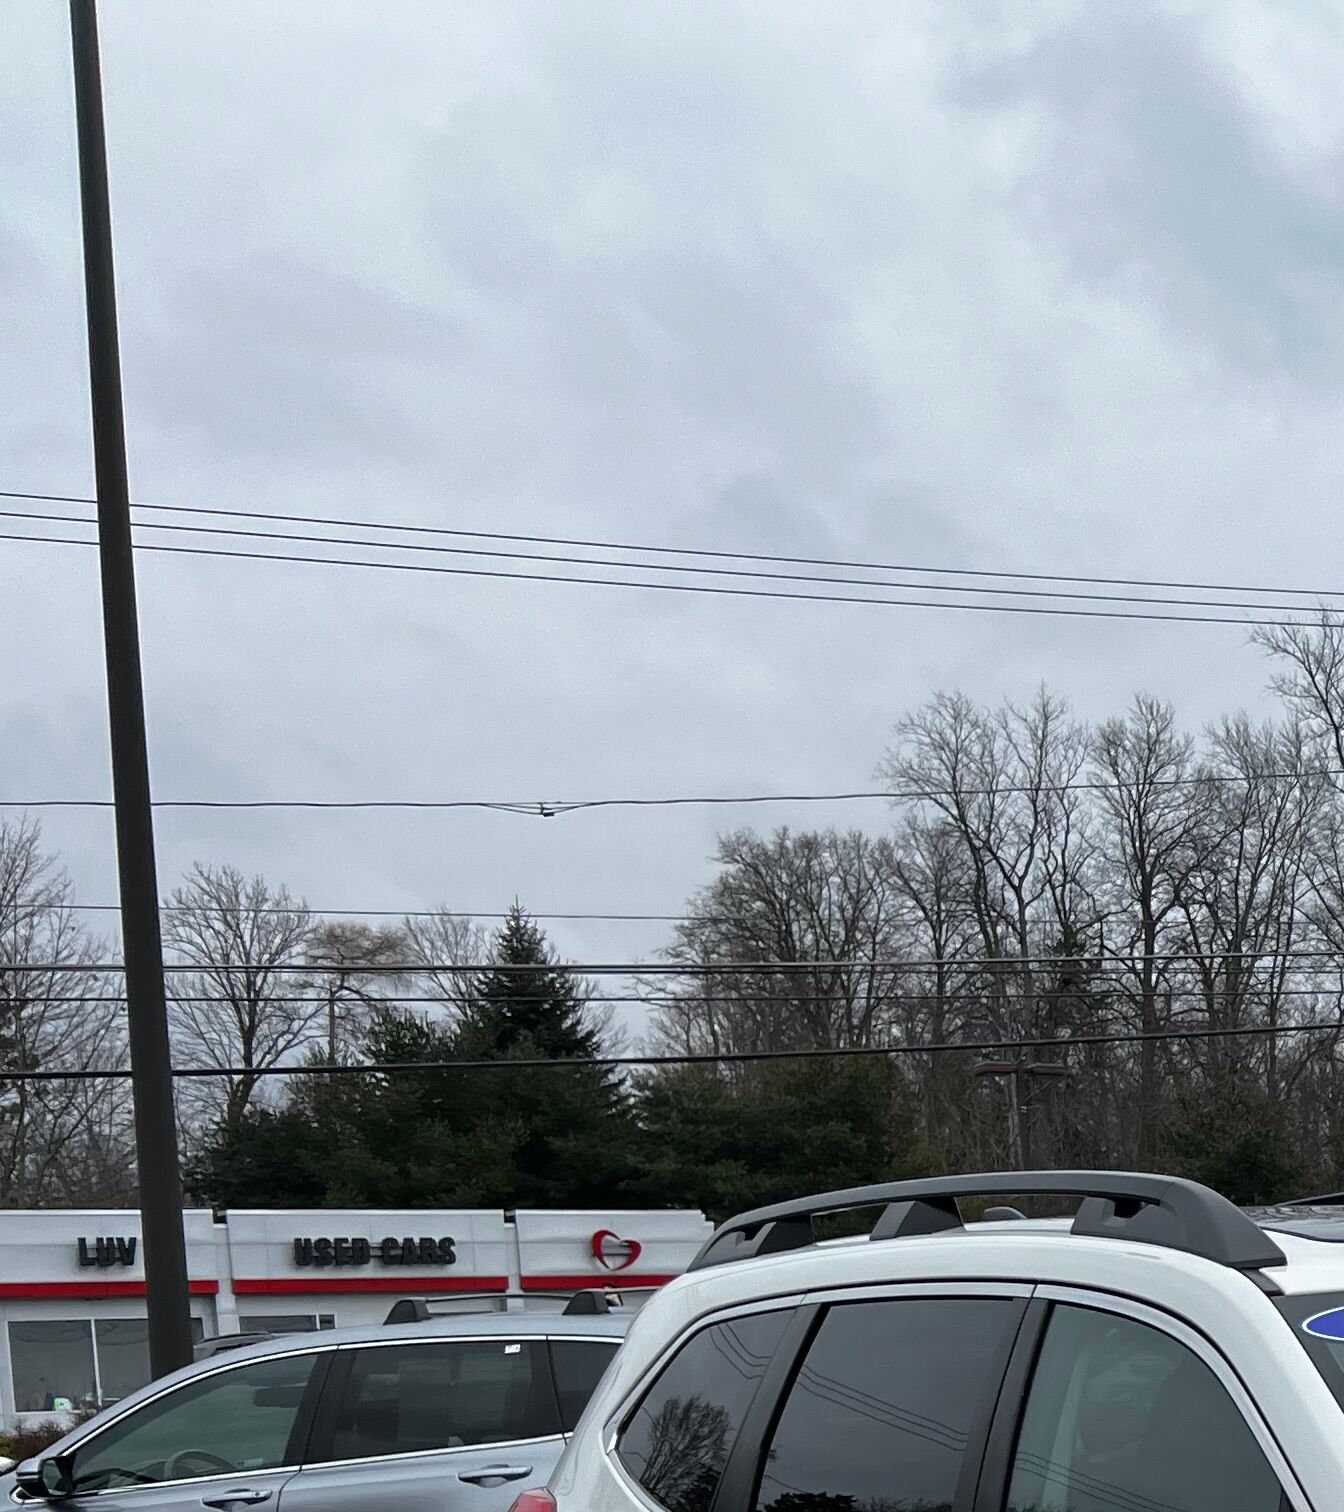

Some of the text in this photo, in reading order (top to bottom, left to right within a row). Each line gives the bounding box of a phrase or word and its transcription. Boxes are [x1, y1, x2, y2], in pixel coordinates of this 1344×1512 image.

[78, 1237, 137, 1266] LUV
[293, 1236, 457, 1266] USED CARS
